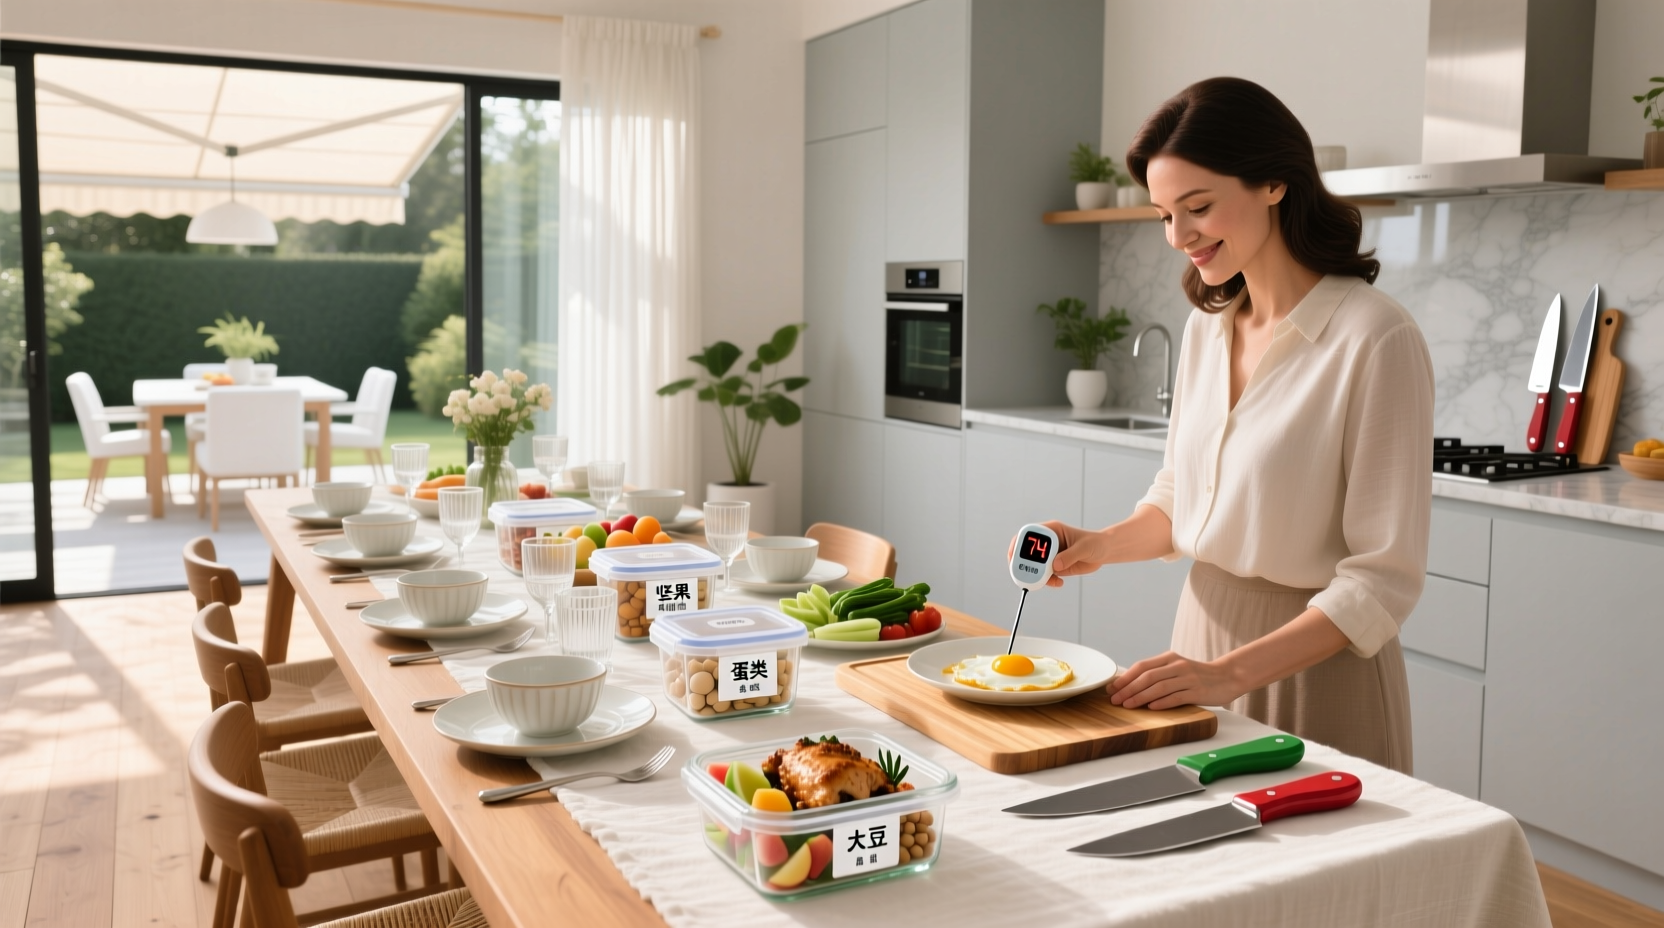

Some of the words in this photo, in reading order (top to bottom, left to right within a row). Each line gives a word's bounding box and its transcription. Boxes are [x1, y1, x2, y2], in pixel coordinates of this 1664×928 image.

[1028, 536, 1048, 558] 74
[656, 583, 691, 601] 坚果
[730, 659, 768, 681] 蛋类
[847, 825, 888, 852] 大豆
